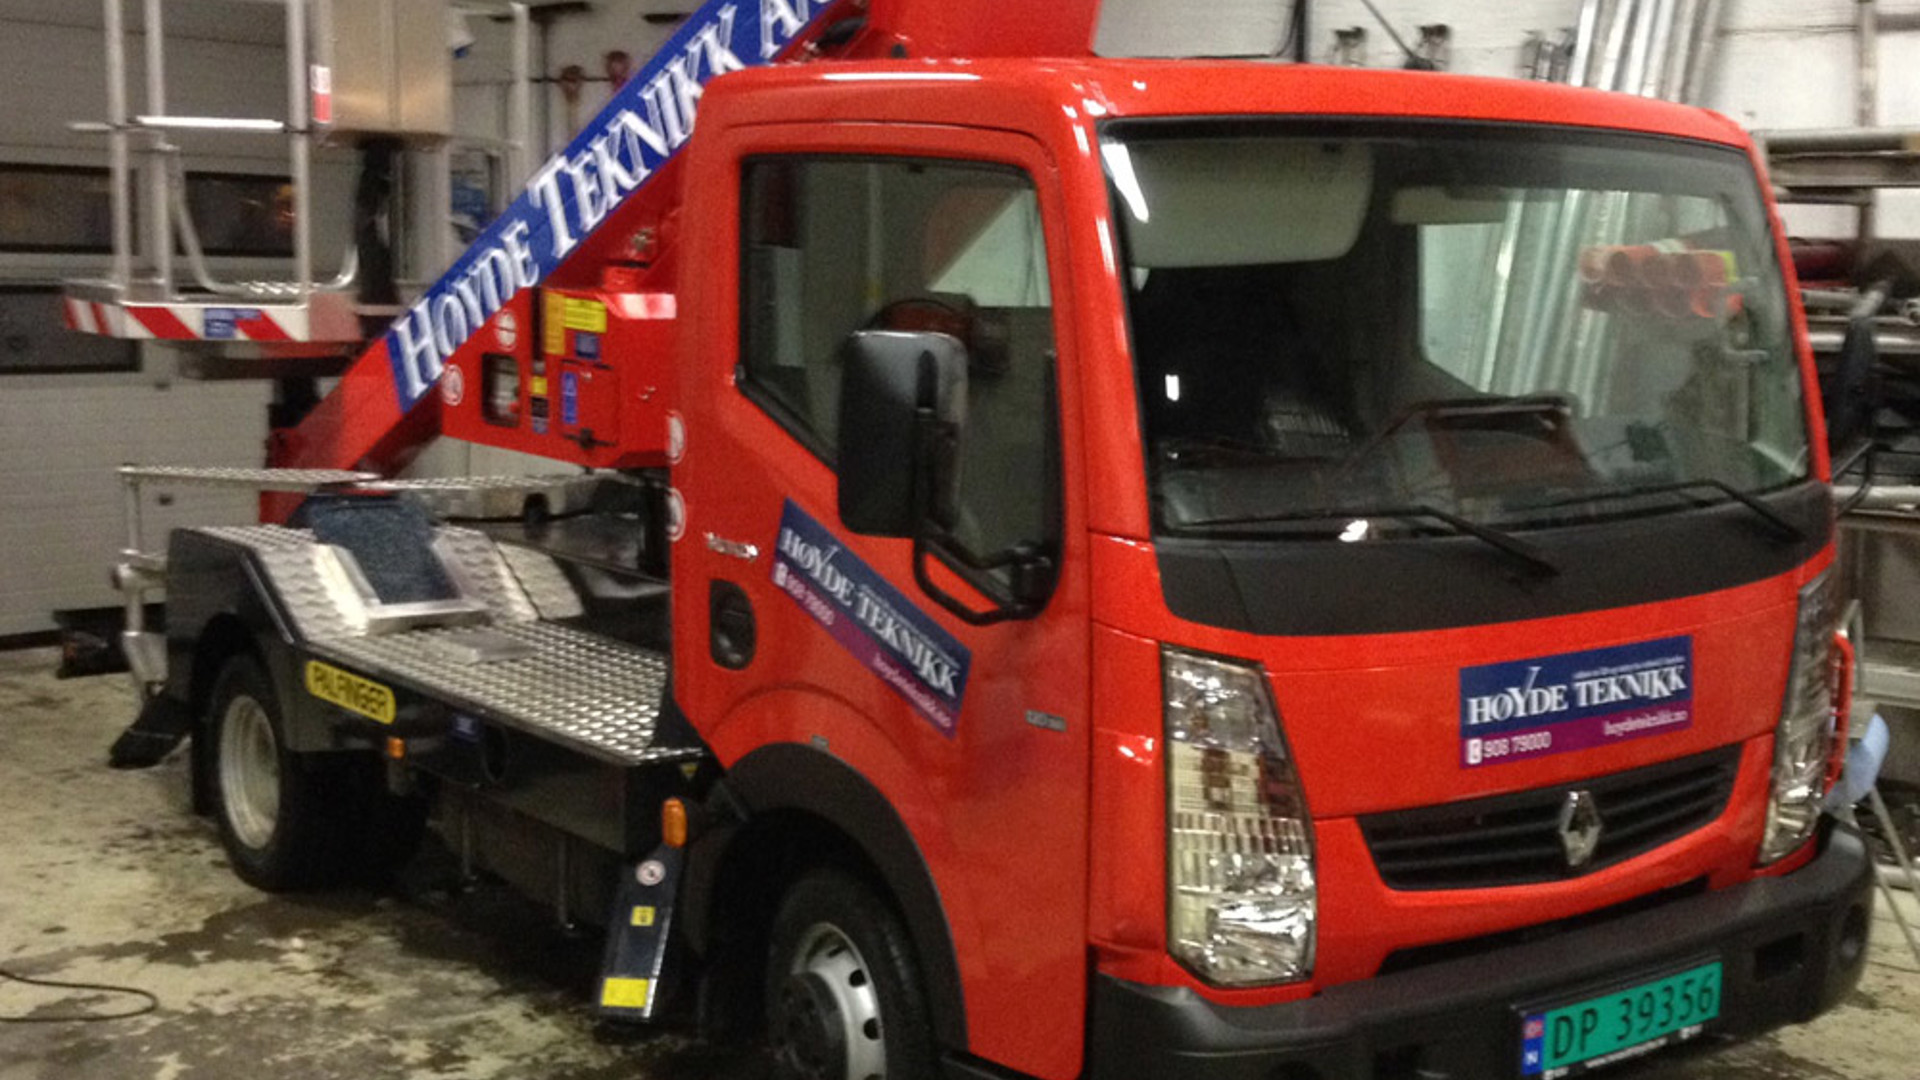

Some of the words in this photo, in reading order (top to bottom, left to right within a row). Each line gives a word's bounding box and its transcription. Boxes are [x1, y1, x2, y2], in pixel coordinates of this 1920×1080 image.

[526, 2, 747, 259] TEKNIKK
[854, 588, 961, 698] TEKNIKK
[1571, 664, 1688, 708] TEKNIKK
[1553, 1007, 1598, 1060] DP
[1616, 972, 1715, 1042] 39356
